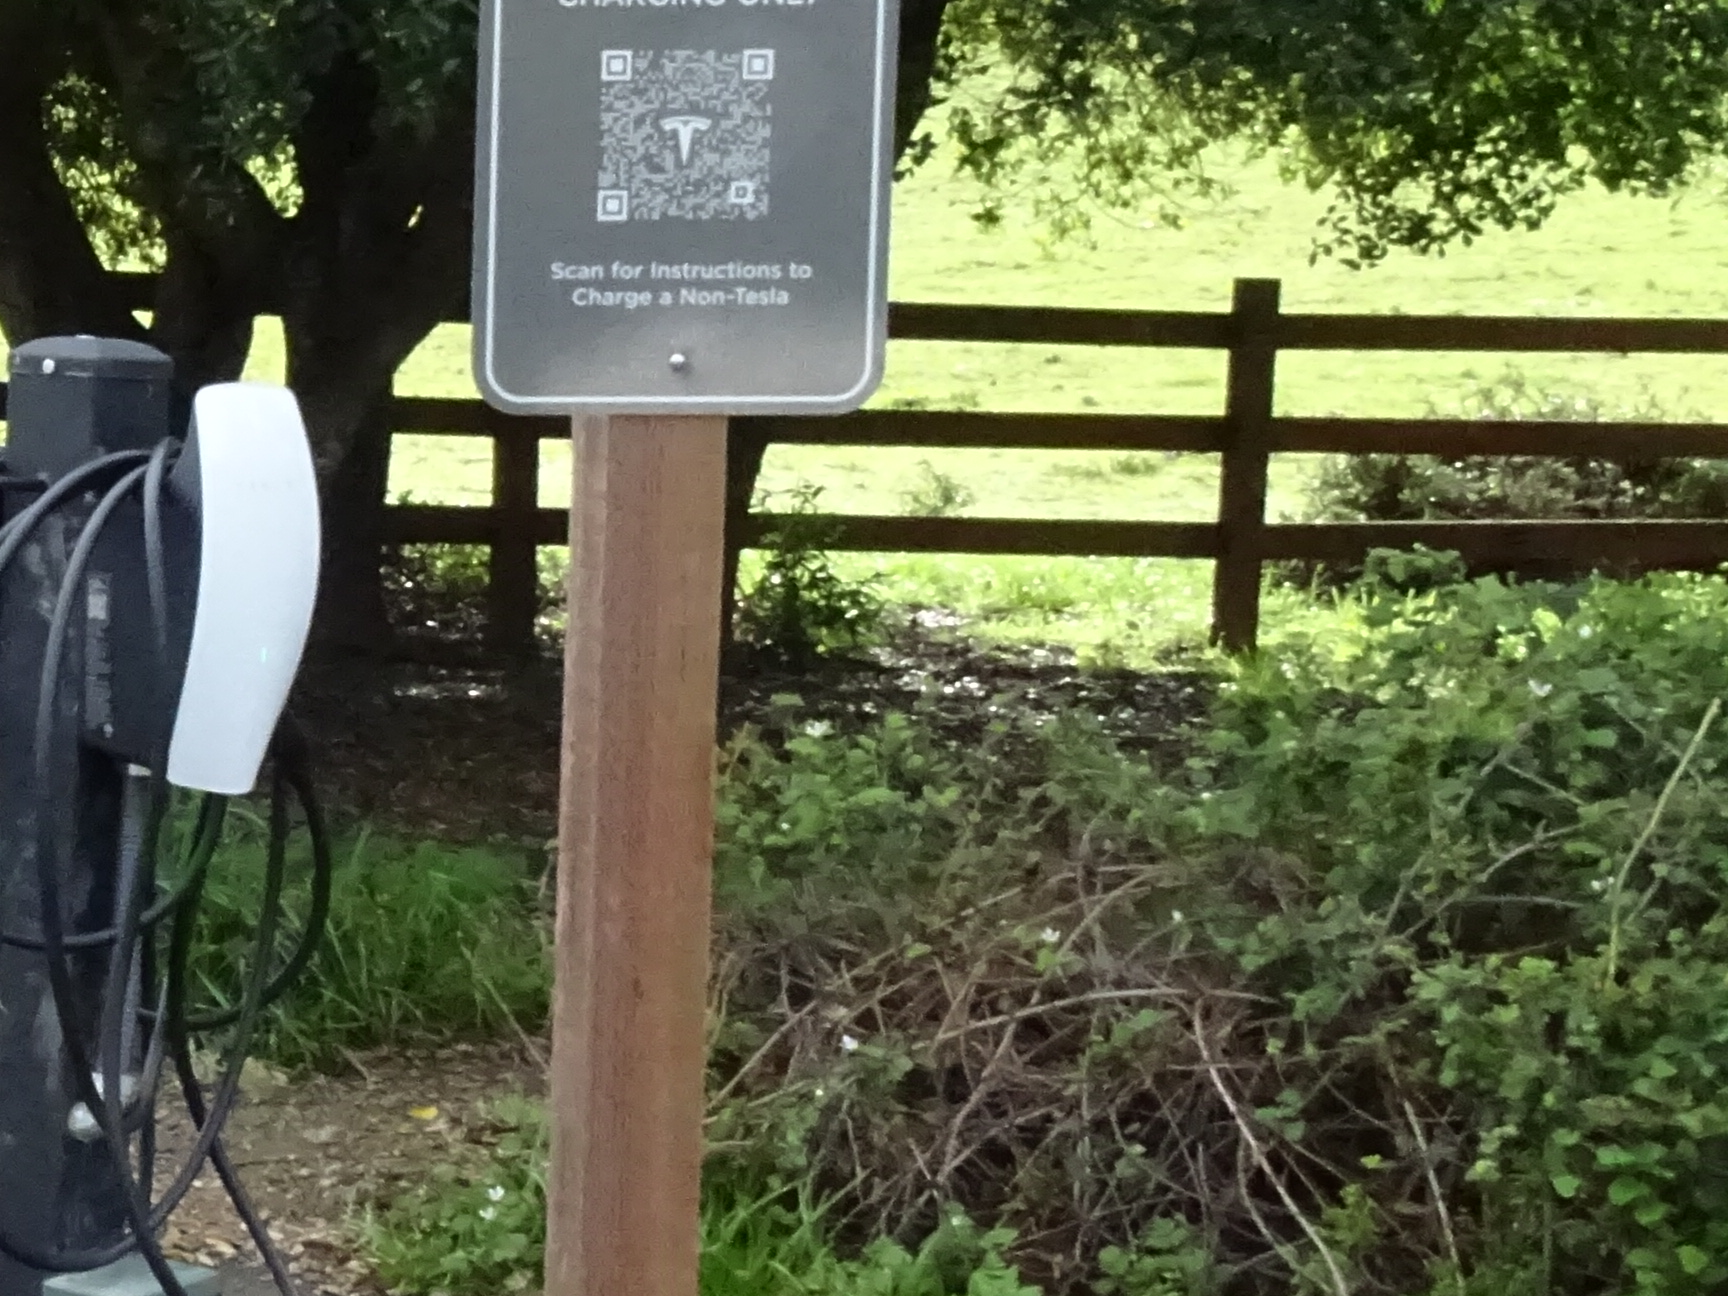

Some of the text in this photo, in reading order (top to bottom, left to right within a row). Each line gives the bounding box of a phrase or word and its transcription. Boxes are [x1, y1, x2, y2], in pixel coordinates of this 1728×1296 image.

[550, 262, 811, 281] Scan for Instructions to
[572, 287, 790, 310] Charge a Non-Tesla
